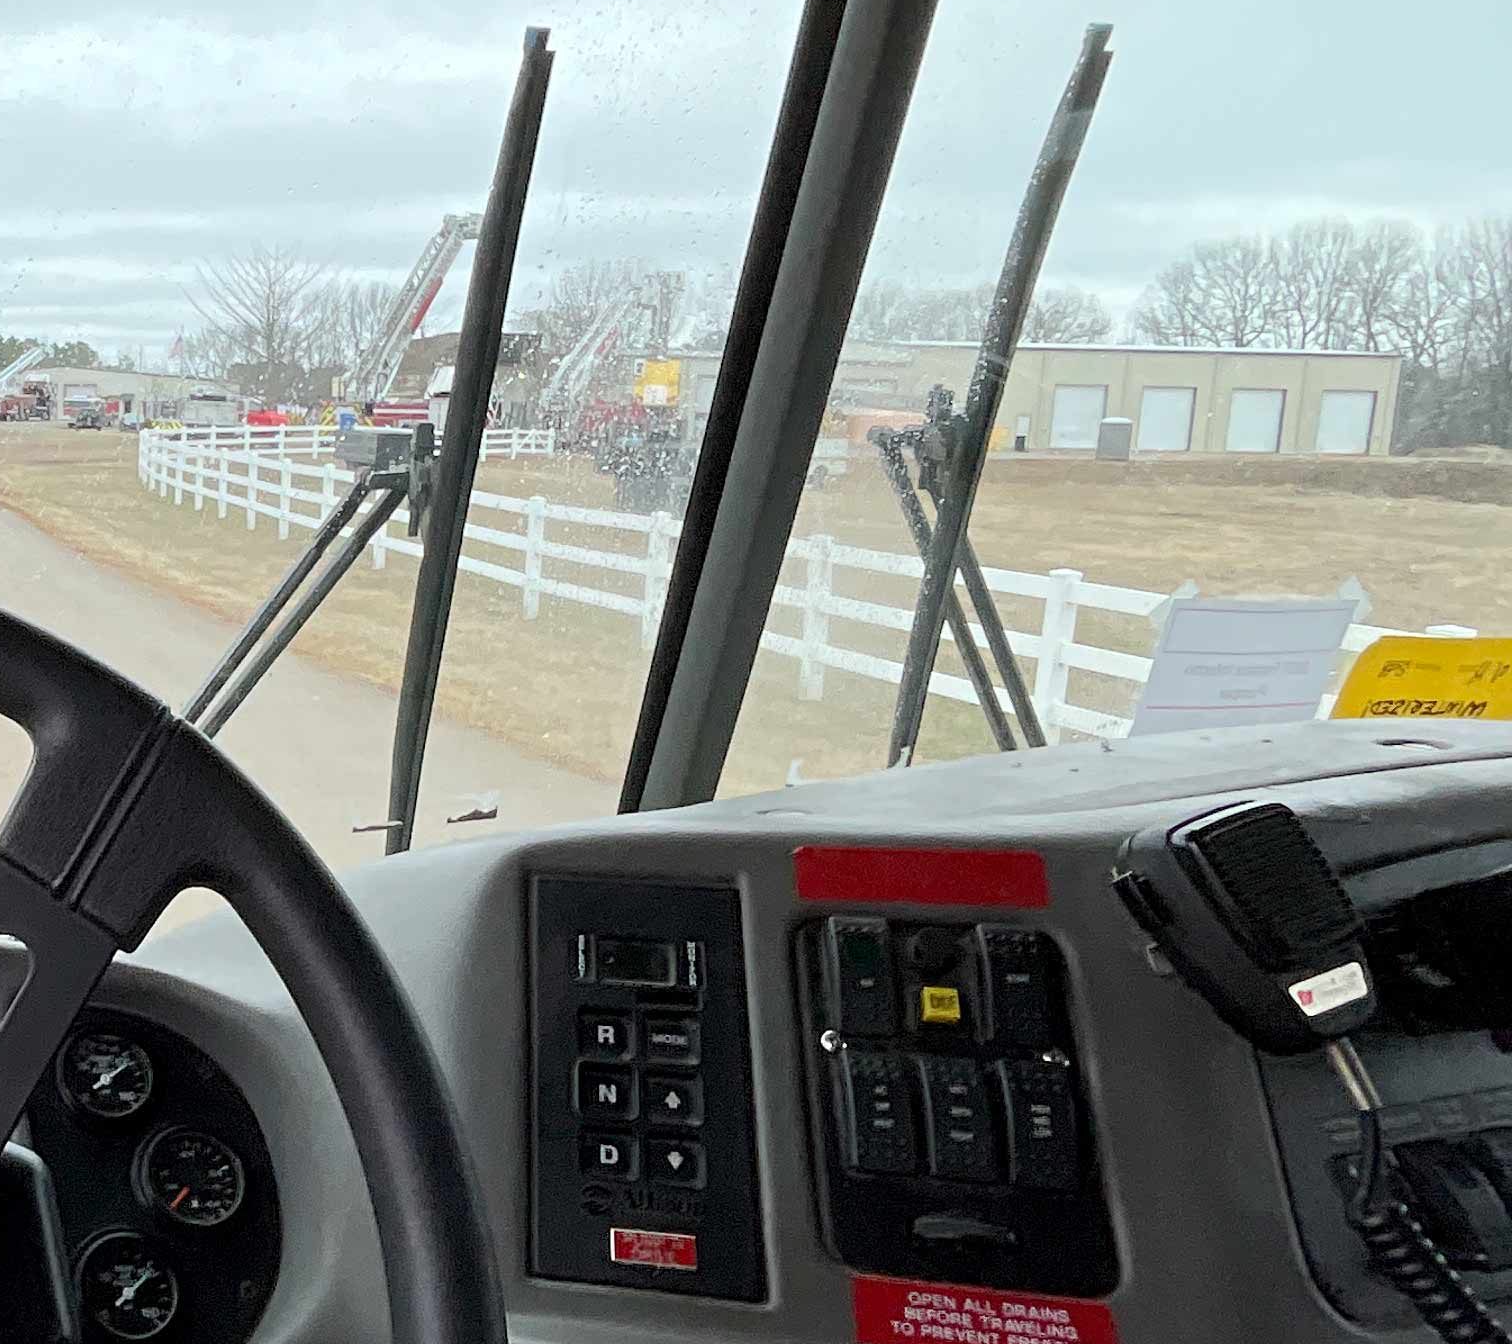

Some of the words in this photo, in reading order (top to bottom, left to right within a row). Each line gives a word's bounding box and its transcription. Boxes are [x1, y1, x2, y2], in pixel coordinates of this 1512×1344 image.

[597, 1025, 615, 1046] R
[598, 1086, 617, 1105] N
[599, 1145, 619, 1165] D
[907, 1291, 956, 1311] OPEN
[964, 1297, 998, 1315] ALL
[1002, 1302, 1071, 1323] DRAINS
[890, 1320, 914, 1336] TO
[904, 1306, 974, 1330] BEFORE
[981, 1314, 1080, 1341] TRAVELING
